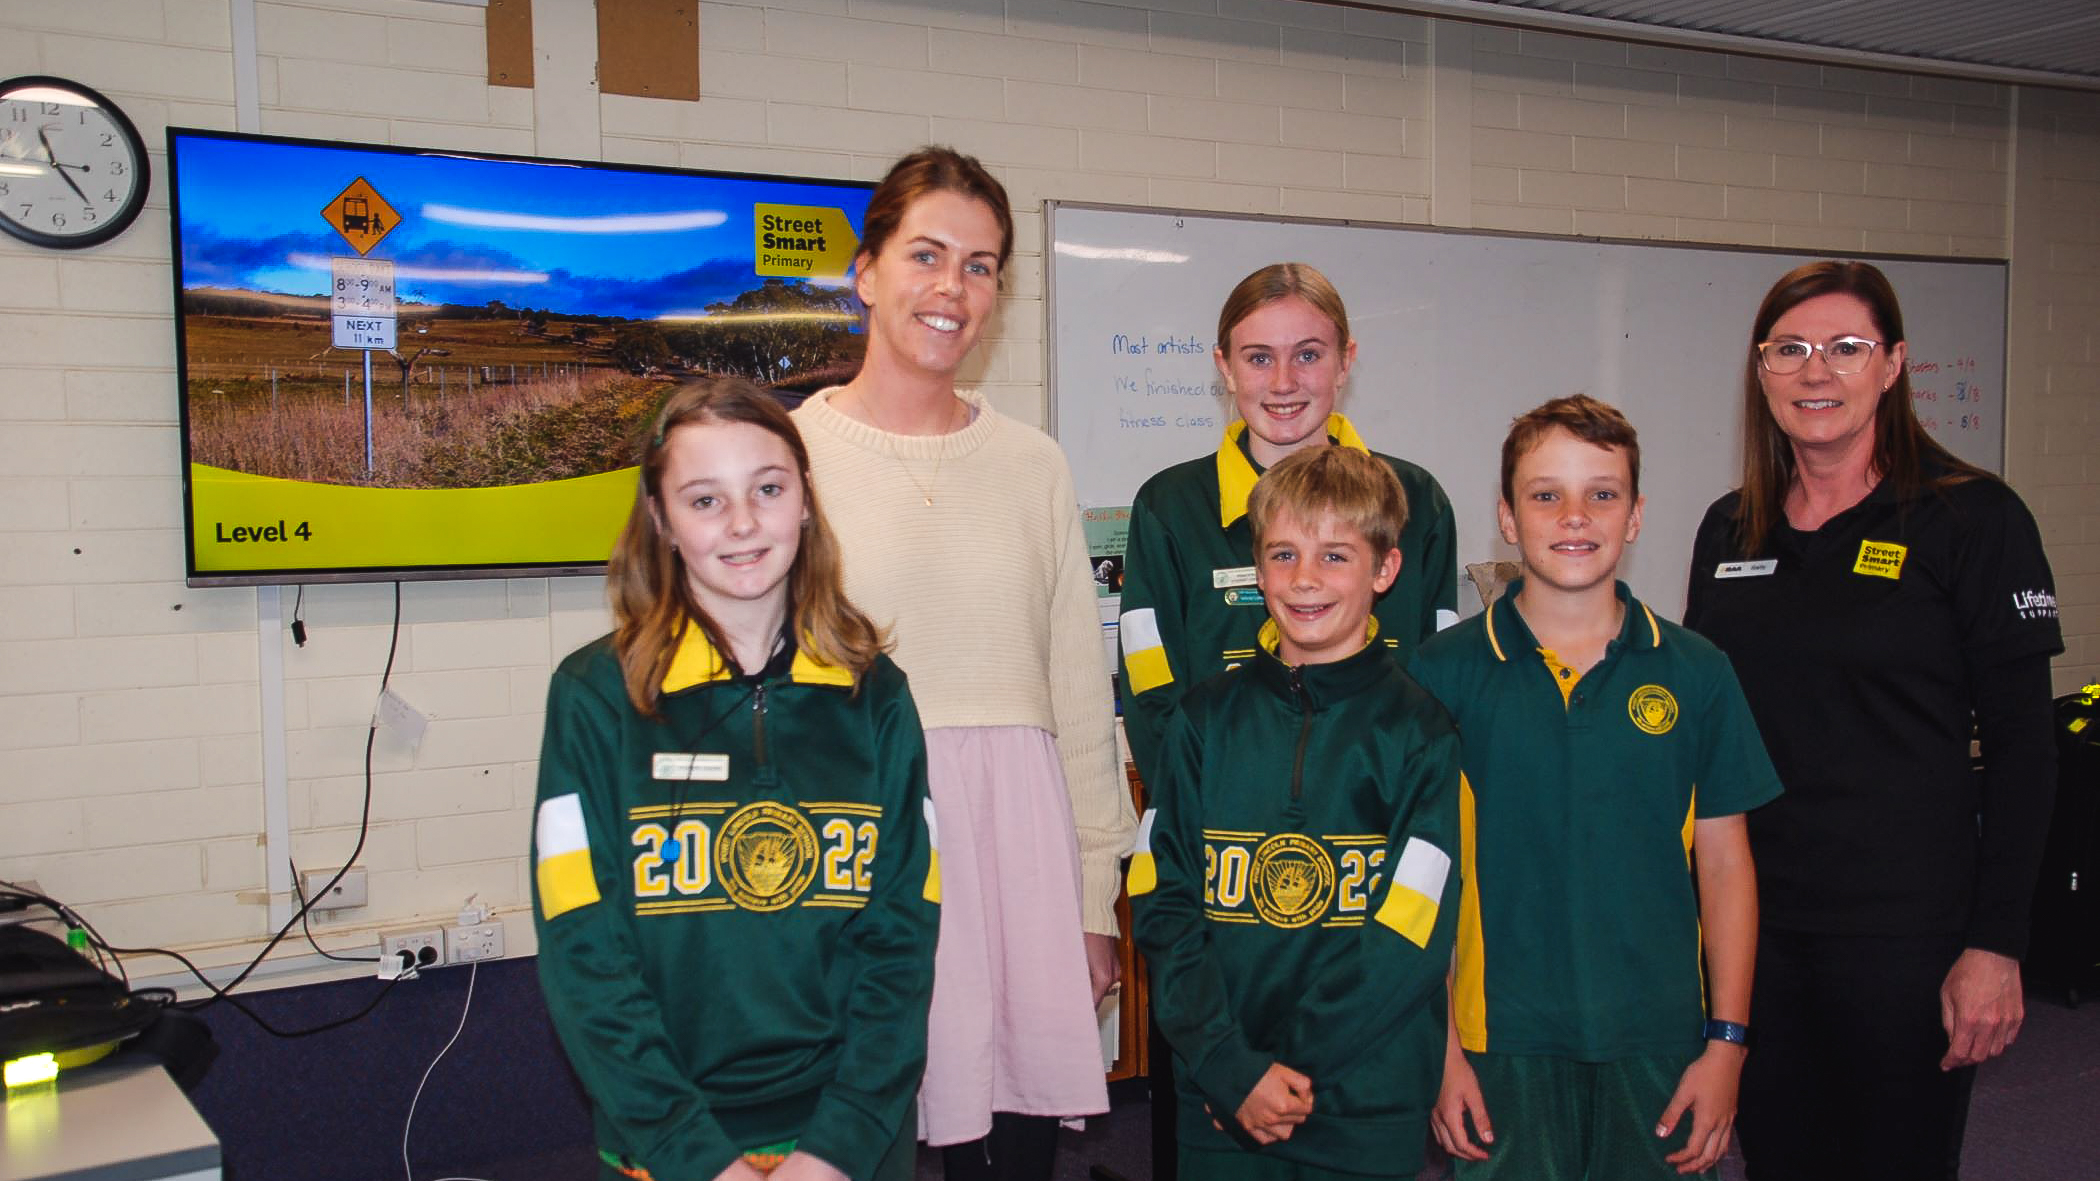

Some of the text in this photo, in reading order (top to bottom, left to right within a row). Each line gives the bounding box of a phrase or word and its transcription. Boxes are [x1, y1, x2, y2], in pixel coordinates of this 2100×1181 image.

[12, 107, 27, 123] 11
[101, 133, 114, 147] 2
[110, 161, 124, 176] 3
[103, 188, 117, 203] 4
[20, 203, 33, 218] 7
[83, 206, 97, 222] 5
[52, 212, 67, 228] 6
[762, 214, 823, 234] Street
[763, 233, 827, 252] Smart
[763, 254, 814, 271] Primary
[346, 320, 383, 331] NEXT
[353, 333, 385, 345] 11 km
[1112, 334, 1148, 354] Most
[1157, 335, 1205, 354] artists
[1113, 375, 1138, 394] We
[1145, 367, 1204, 396] finished
[1175, 415, 1215, 428] class
[215, 520, 313, 543] Level 4
[1864, 545, 1900, 558] Street
[1862, 554, 1900, 567] Smart
[631, 819, 712, 898] 20
[822, 818, 879, 892] 22
